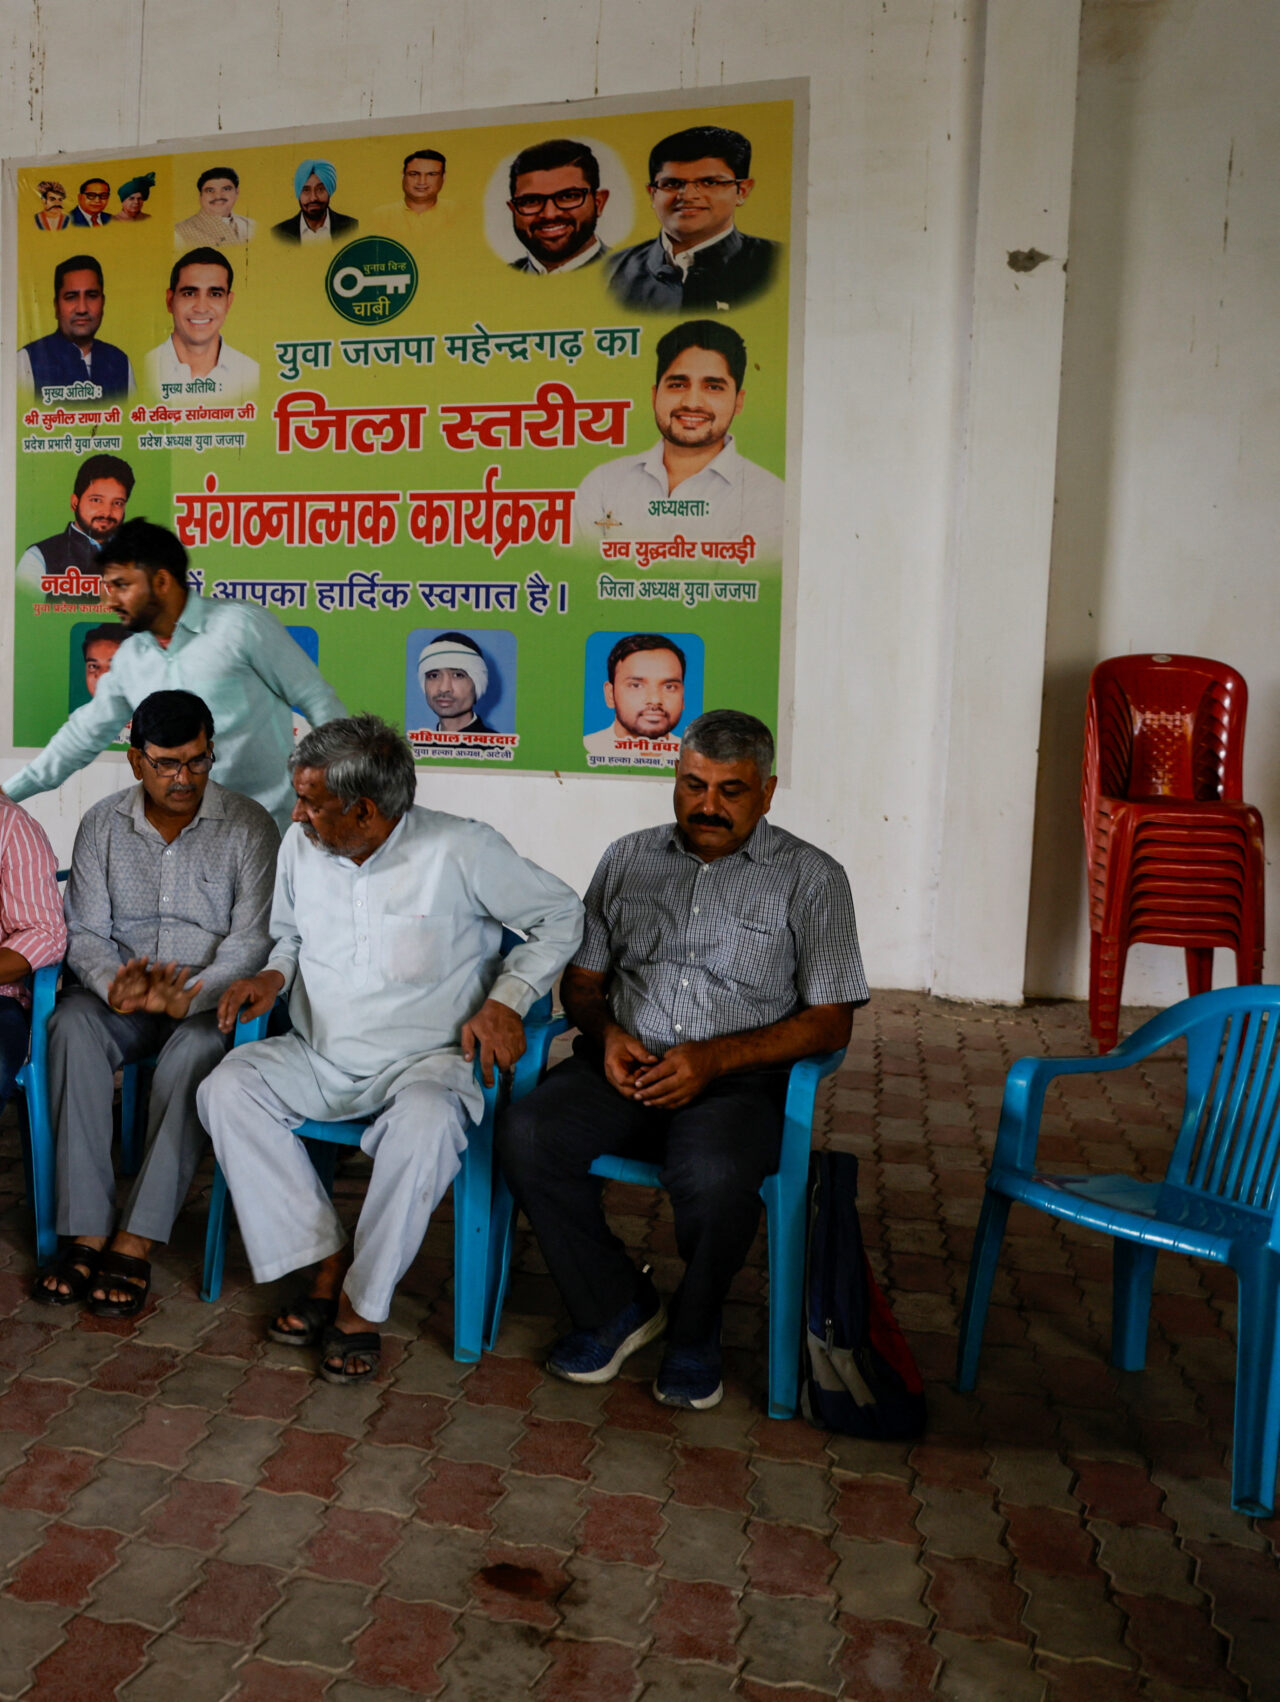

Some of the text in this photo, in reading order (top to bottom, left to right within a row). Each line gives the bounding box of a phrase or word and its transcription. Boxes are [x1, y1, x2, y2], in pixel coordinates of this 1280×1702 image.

[363, 264, 386, 275] चुनाव
[352, 296, 391, 316] चाबी
[276, 323, 640, 380] युवा जजपा महेन्द्रगढ़ का
[44, 387, 64, 404] मुख्य
[162, 383, 182, 399] मुख्य
[25, 407, 120, 431] श्री सुनील राणा जी
[131, 403, 255, 423] श्री रविन्द्र सांगवान जी
[274, 382, 631, 453] जिला स्तरीय
[24, 434, 120, 453] प्रदेश प्रभारी युवा जजपा
[139, 433, 245, 451] प्रदेश अध्यक्ष युवा जजपा
[176, 466, 575, 558] संगठनात्मक कार्यक्रम
[602, 541, 631, 558] राव
[636, 535, 698, 567] युद्धवीर
[41, 567, 100, 595] नवीन
[213, 581, 306, 608] आपका
[316, 573, 409, 609] हार्दिक
[599, 575, 757, 606] जिला अध्यक्ष युवा जजपा
[408, 730, 460, 742] महिपाल
[614, 738, 650, 750] जोनी
[414, 747, 429, 757] युवा
[588, 755, 605, 765] युवा
